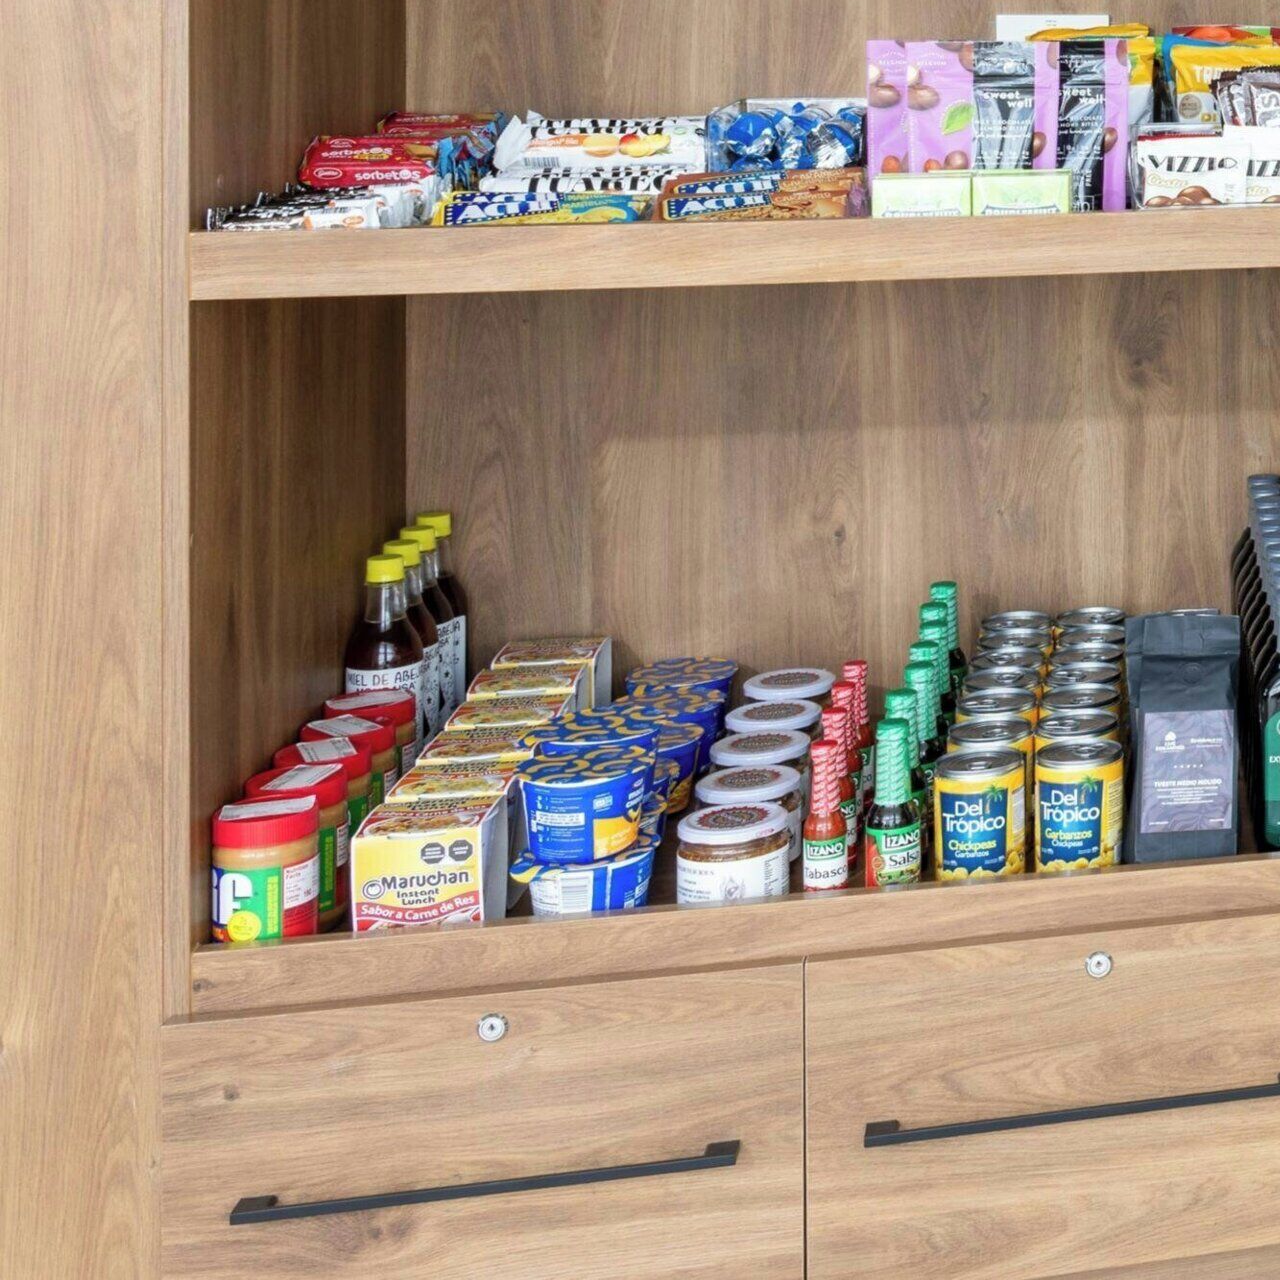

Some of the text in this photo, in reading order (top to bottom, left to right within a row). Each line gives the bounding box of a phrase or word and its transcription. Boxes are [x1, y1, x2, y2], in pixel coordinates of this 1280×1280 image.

[983, 91, 1020, 99] sweet
[1007, 99, 1032, 108] well
[1148, 155, 1238, 173] VIZZIO
[457, 200, 529, 220] ACT
[681, 197, 745, 213] ACT
[373, 674, 388, 685] DE
[1051, 788, 1078, 806] Del
[955, 798, 982, 817] Del
[1041, 800, 1100, 827] Trópico
[942, 813, 1006, 838] Trópico
[1045, 827, 1093, 841] Garbanzos
[807, 843, 844, 858] LIZANO
[948, 839, 997, 852] Chickpeas
[1052, 839, 1084, 848] Chickpeas
[954, 850, 989, 859] Garbanzos
[805, 864, 847, 879] Tabasco
[382, 871, 469, 889] Maruchan
[397, 888, 439, 898] Instant
[361, 905, 394, 918] Sabor
[405, 908, 438, 920] Carne
[442, 903, 454, 913] de
[455, 895, 475, 907] Res
[402, 897, 435, 905] Lunch
